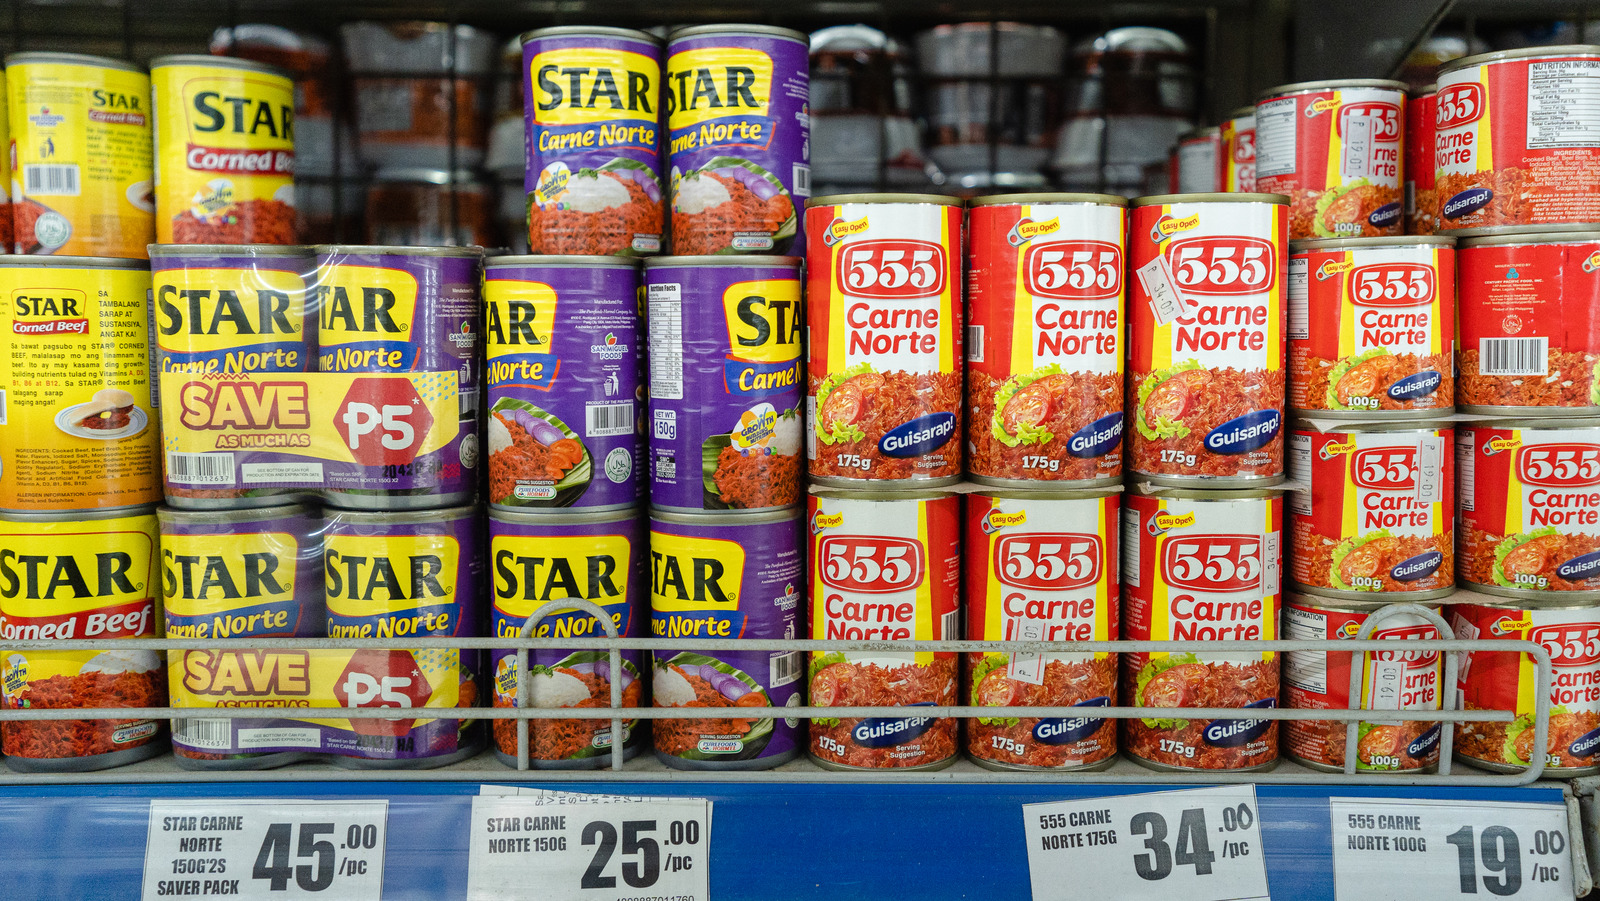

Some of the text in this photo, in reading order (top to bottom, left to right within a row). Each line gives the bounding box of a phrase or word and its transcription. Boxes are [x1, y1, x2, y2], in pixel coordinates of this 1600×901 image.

[1573, 61, 1600, 69] INFORMA
[92, 89, 140, 110] STAR
[538, 64, 653, 114] STAR
[539, 124, 655, 152] Carne Norte
[699, 121, 761, 146] Norte
[1436, 131, 1474, 152] Carne
[188, 148, 272, 171] Corned
[1436, 148, 1471, 169] Norte
[1444, 190, 1488, 215] Guisarap!
[834, 220, 868, 234] Easy Open
[1021, 221, 1059, 234] Easy Open
[1162, 218, 1198, 231] Easy Open
[1334, 222, 1362, 234] 100g
[848, 250, 937, 289] 555
[1037, 251, 1117, 290] 555
[1177, 247, 1266, 286] 555
[1339, 262, 1353, 270] Open
[1359, 270, 1429, 300] 555
[16, 295, 80, 317] STAR
[158, 284, 296, 336] STAR
[318, 285, 402, 333] TAR
[847, 302, 938, 329] Carne
[1035, 303, 1118, 330] Carne
[1175, 298, 1267, 326] Carne
[13, 320, 88, 334] Corned Beef
[488, 300, 541, 346] AR
[736, 295, 801, 347] STA
[1360, 310, 1428, 329] Carne
[591, 344, 629, 353] SAN MIGUEL
[849, 330, 936, 356] Norte
[1037, 331, 1116, 357] Norte
[1175, 326, 1264, 352] Norte
[1362, 328, 1426, 348] Norte
[162, 348, 298, 373] Carne Norte
[336, 347, 403, 371] Norte
[491, 359, 543, 385] Norte
[739, 367, 793, 392] Carne
[1390, 374, 1440, 396] Guisarap!
[180, 381, 311, 431] SAVE
[1347, 396, 1379, 408] 100g
[655, 421, 676, 439] 150g
[741, 409, 775, 437] GROWTH
[883, 415, 954, 452] Guisarap!
[1209, 413, 1279, 448] Guisarap!
[215, 433, 311, 449] AS MUCH AS
[837, 454, 871, 471] 175g
[917, 460, 948, 469] Suggestion
[923, 454, 944, 462] Serving
[1021, 455, 1060, 471] 175g
[1160, 449, 1197, 467] 175g
[1527, 451, 1600, 480] 555
[1528, 489, 1600, 508] Carne
[816, 515, 842, 526] Easy Open
[992, 514, 1025, 525] Easy Open
[1159, 515, 1194, 526] Easy Open
[1365, 510, 1428, 529] Norte
[1530, 508, 1598, 526] Norte
[826, 543, 911, 584] 555
[1005, 541, 1093, 581] 555
[1173, 543, 1261, 582] 555
[1394, 553, 1441, 577] Guisarap!
[0, 549, 138, 600] STAR
[162, 548, 286, 600] STAR
[326, 548, 448, 601] STAR
[496, 549, 621, 601] STAR
[651, 550, 730, 603] TAR
[1350, 576, 1382, 590] 100g
[1514, 573, 1547, 587] 100g
[825, 594, 914, 622] Carne
[1003, 592, 1094, 620] Carne
[1171, 594, 1262, 622] Carne
[0, 604, 152, 640] Corned Beef
[212, 610, 288, 638] Norte
[328, 612, 449, 638] Carne Norte
[668, 615, 731, 638] Norte
[827, 619, 911, 640] Norte
[1173, 621, 1260, 641] Norte
[1540, 629, 1600, 659] 555
[183, 649, 311, 696] SAVE
[819, 735, 846, 756] 175g
[890, 750, 926, 759] Suggestion
[896, 743, 921, 752] Serving
[992, 735, 1025, 756] 175g
[1159, 738, 1196, 758] 175g
[1369, 755, 1400, 767] 100g
[163, 816, 243, 831] STAR CARNE
[487, 816, 566, 833] STAR CARNE
[1040, 809, 1112, 829] 555 CARNE
[1348, 814, 1421, 831] 555 CARNE
[180, 837, 222, 852] NORTE
[488, 836, 567, 854] NORTE 150G
[1041, 829, 1117, 850] NORTE 175G
[1129, 808, 1215, 881] 34
[1222, 840, 1249, 858] /pc
[1348, 835, 1427, 852] NORTE 100G
[252, 823, 336, 892] 45
[581, 820, 660, 889] 25
[664, 853, 693, 872] /pc
[1446, 825, 1522, 896] 19
[171, 858, 227, 874] 150G'2S
[338, 857, 367, 876] /pc
[1531, 863, 1559, 882] /pc
[157, 880, 239, 896] SAVER PACK
